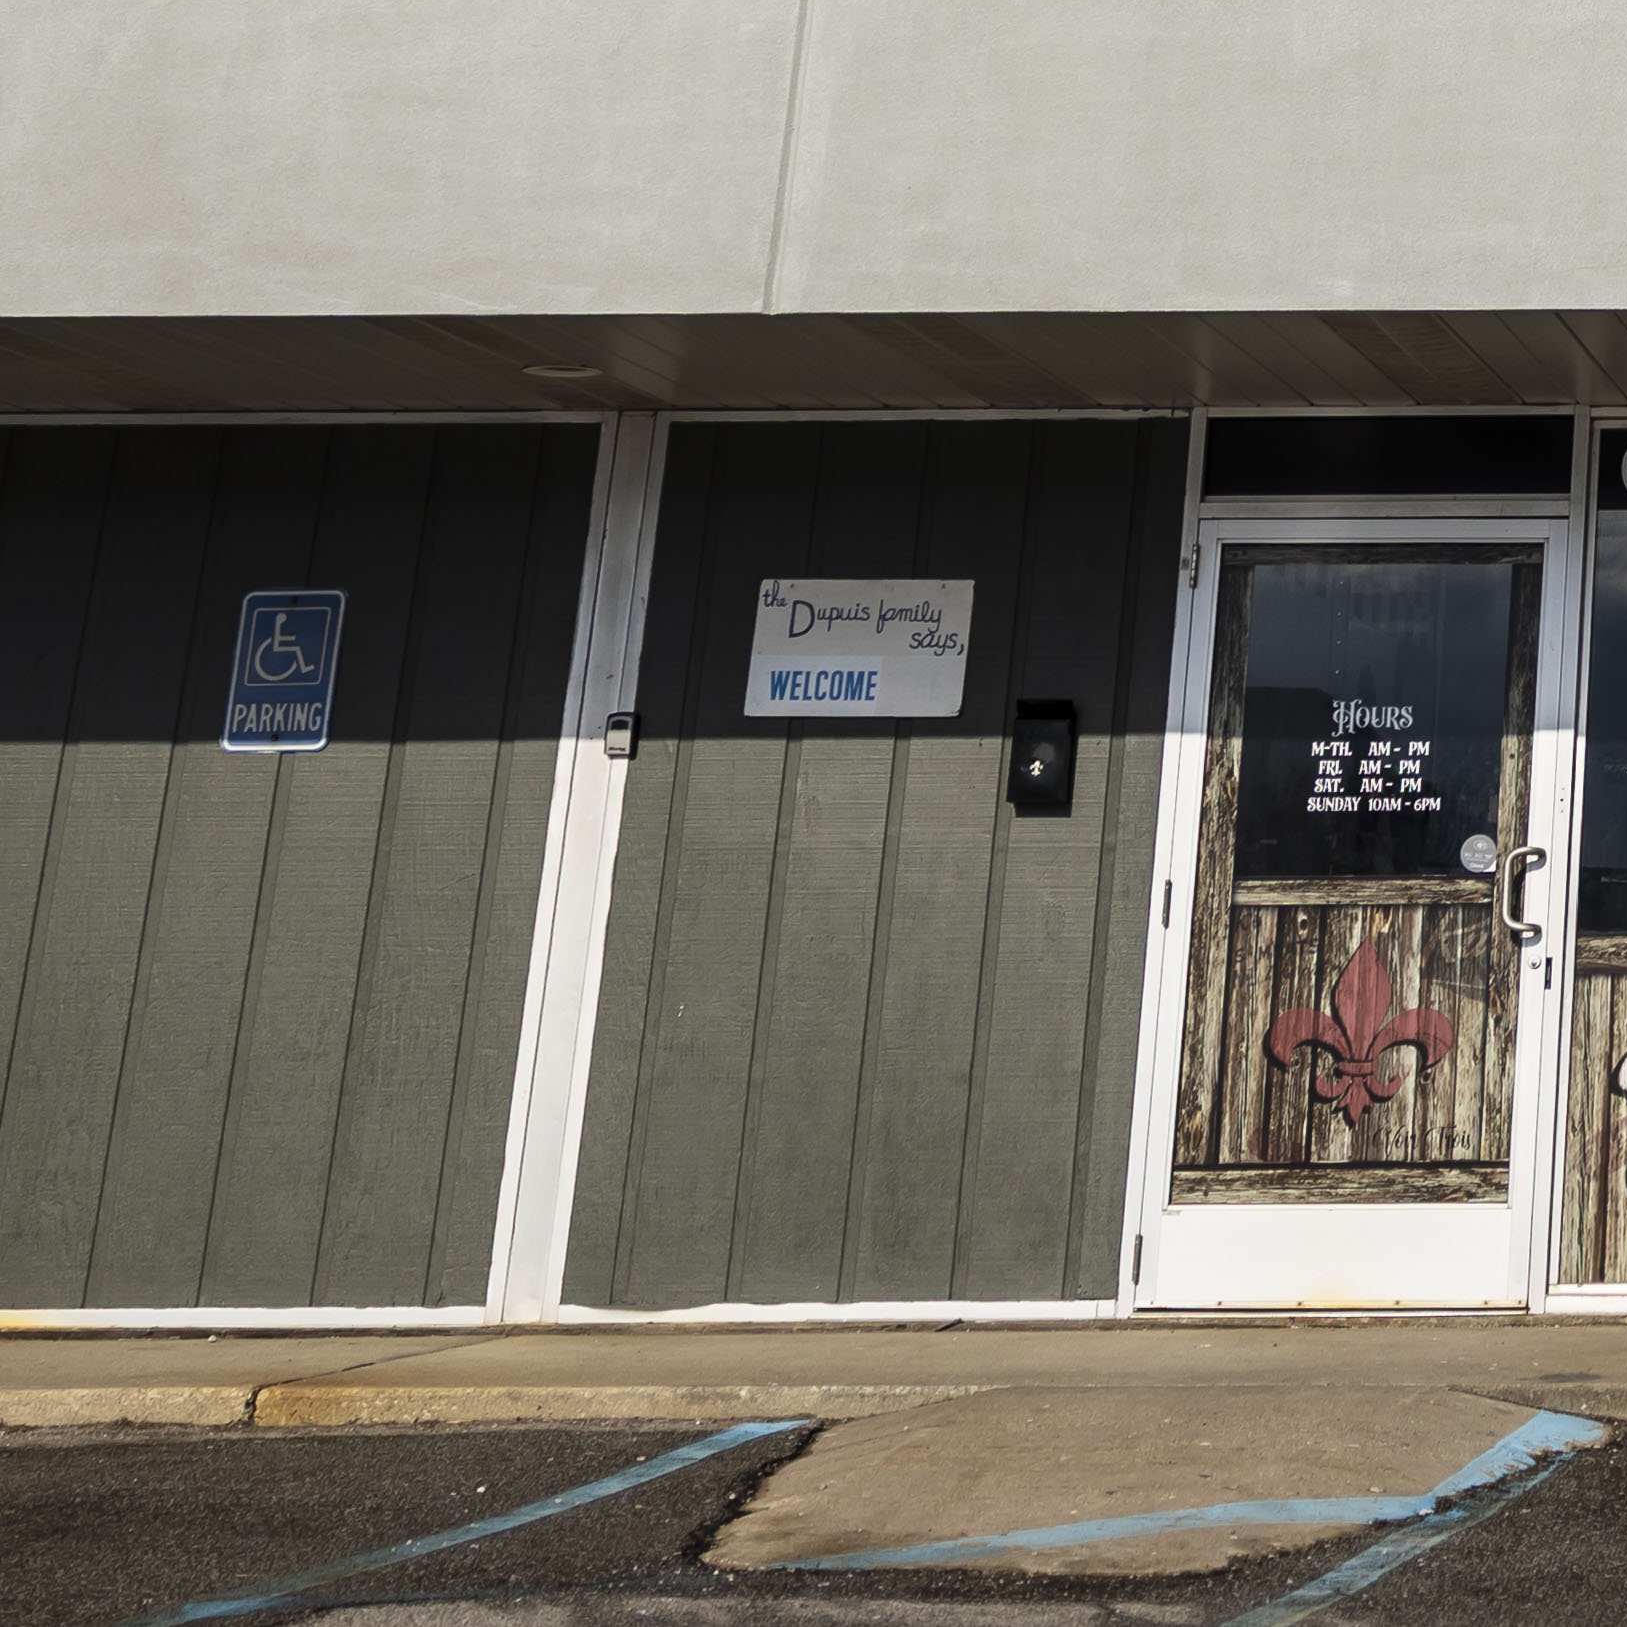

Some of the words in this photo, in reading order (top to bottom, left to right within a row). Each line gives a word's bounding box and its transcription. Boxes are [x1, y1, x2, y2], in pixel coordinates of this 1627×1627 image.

[762, 580, 788, 608] the
[788, 599, 871, 639] Dupuis
[876, 599, 942, 634] family
[909, 631, 965, 656] says,
[769, 670, 878, 701] WELCOME
[232, 702, 322, 733] PARKING
[1368, 741, 1391, 756] AM
[1408, 741, 1431, 756] PM
[1358, 759, 1381, 775] AM
[1399, 759, 1421, 775] PM
[1314, 777, 1345, 793] SAT.
[1360, 777, 1383, 793] AM
[1400, 777, 1422, 793] PM
[1307, 796, 1361, 812] SUNDAY
[1368, 797, 1402, 812] 10AM
[1413, 796, 1441, 811] 6PM
